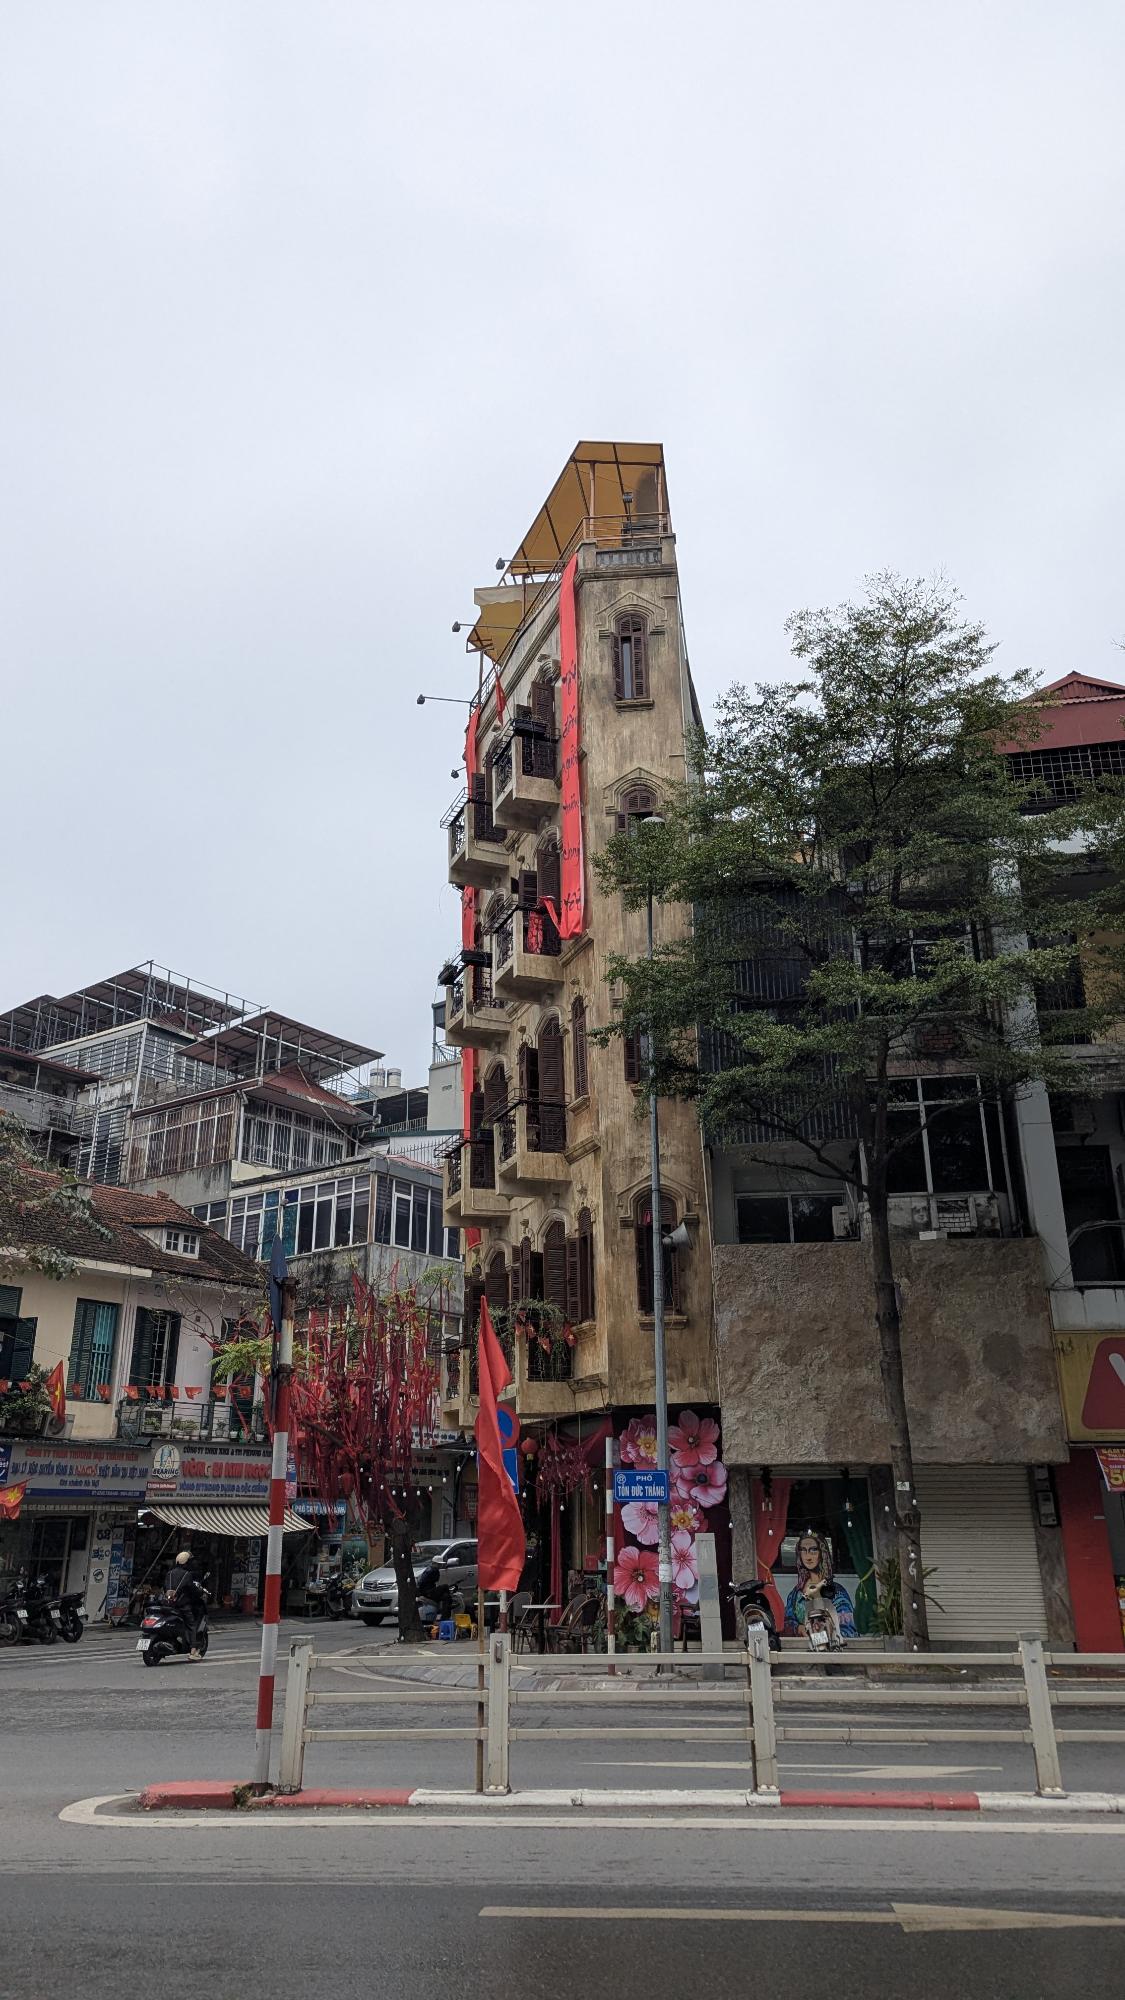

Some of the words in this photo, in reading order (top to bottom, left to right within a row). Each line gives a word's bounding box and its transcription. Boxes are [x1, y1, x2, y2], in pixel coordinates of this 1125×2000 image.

[636, 1473, 652, 1482] PHỐ
[1110, 1469, 1125, 1485] 5
[631, 1483, 643, 1496] ĐỨC
[645, 1481, 665, 1496] THẮNG
